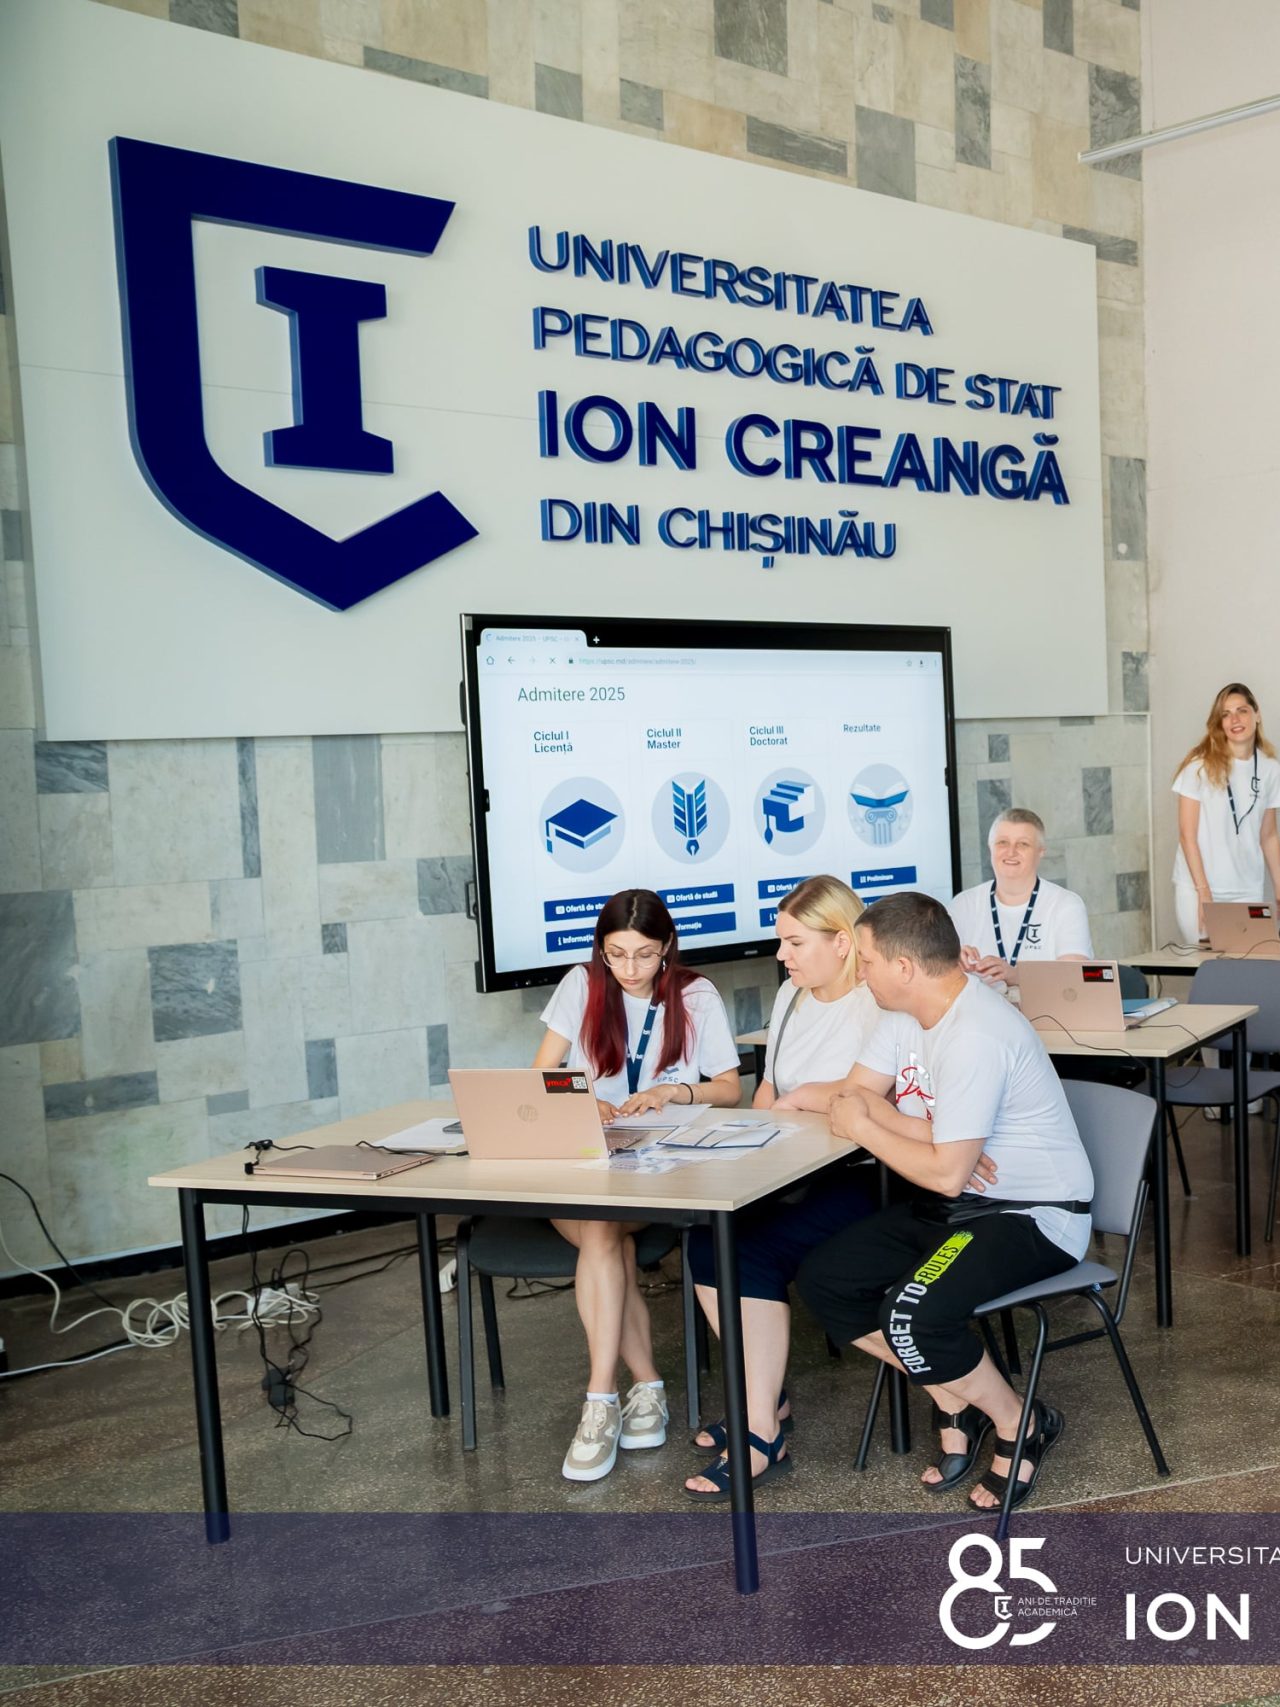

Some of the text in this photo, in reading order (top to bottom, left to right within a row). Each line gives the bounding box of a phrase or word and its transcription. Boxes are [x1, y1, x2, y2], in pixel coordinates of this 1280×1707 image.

[528, 225, 934, 336] UNIVERSITATEA
[532, 306, 1062, 420] PEDAGOGICĂ DE STAT
[538, 389, 1070, 505] ION CREANGĂ
[540, 498, 897, 569] DIN CHIȘINĂU
[517, 686, 626, 702] Admitere 2025
[646, 728, 673, 738] Ciclul
[749, 725, 784, 736] Ciclul III
[843, 723, 881, 733] Rezultate
[533, 731, 564, 741] Ciclul
[750, 736, 788, 746] Doctorat
[647, 740, 681, 749] Master
[889, 1245, 959, 1374] FORGET TO RULES
